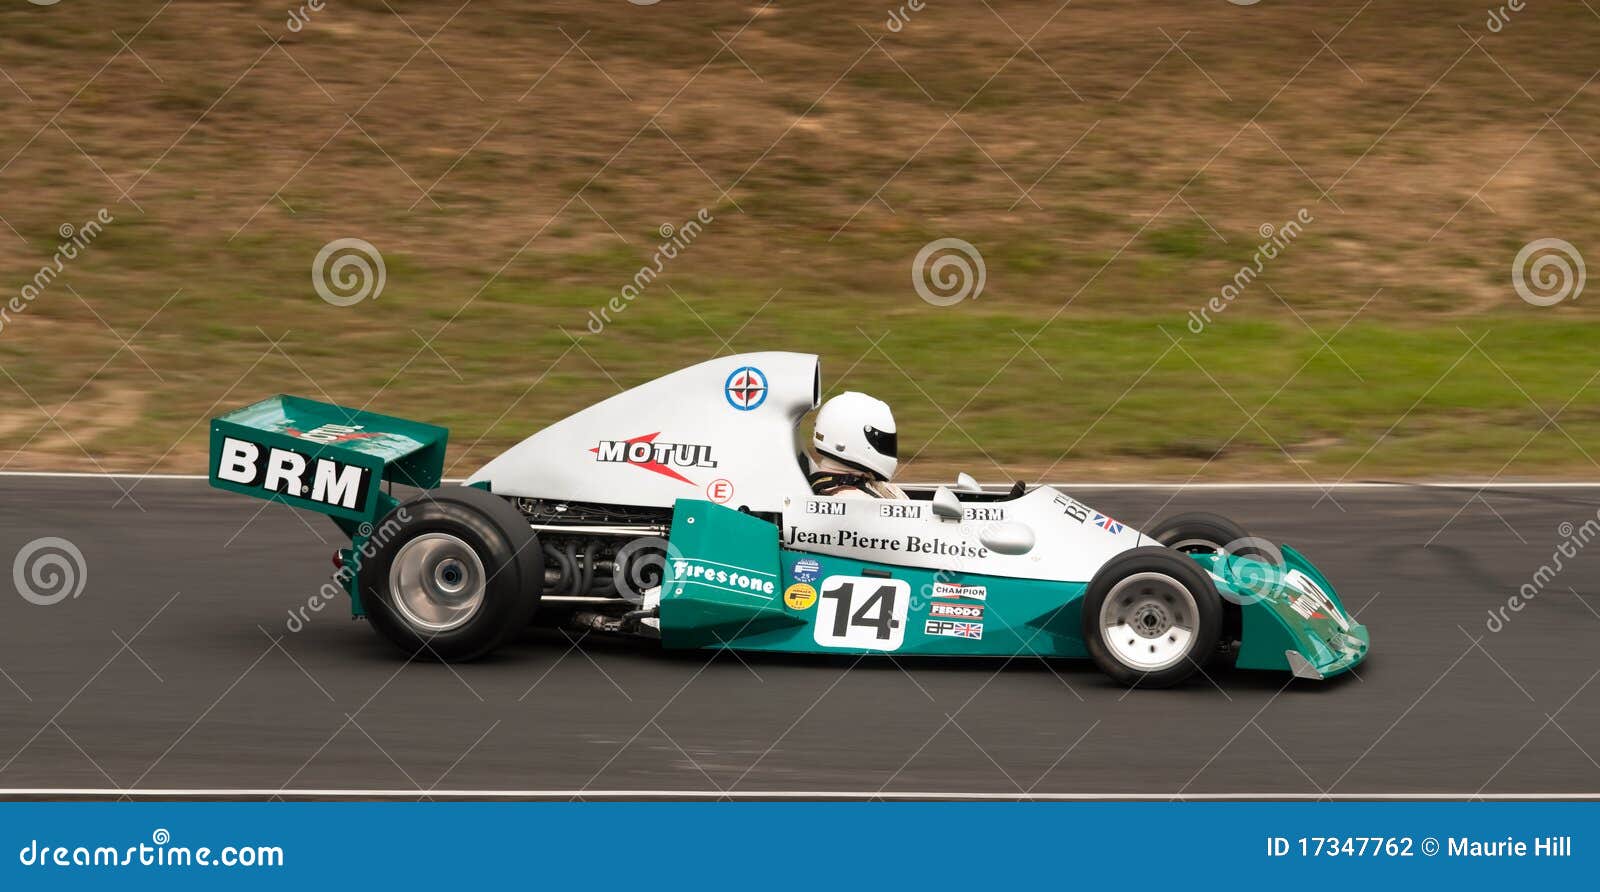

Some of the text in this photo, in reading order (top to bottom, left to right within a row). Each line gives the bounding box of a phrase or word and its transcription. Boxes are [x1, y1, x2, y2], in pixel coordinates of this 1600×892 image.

[597, 440, 718, 469] MOTUL
[217, 436, 370, 511] BRM
[806, 501, 846, 516] BRM
[880, 504, 921, 519] BRM
[963, 507, 1005, 521] BRM
[907, 535, 989, 559] Beltoise
[673, 560, 775, 595] Firestone
[935, 586, 985, 597] CHAMPION
[822, 582, 900, 640] 14
[931, 604, 981, 617] FERODO
